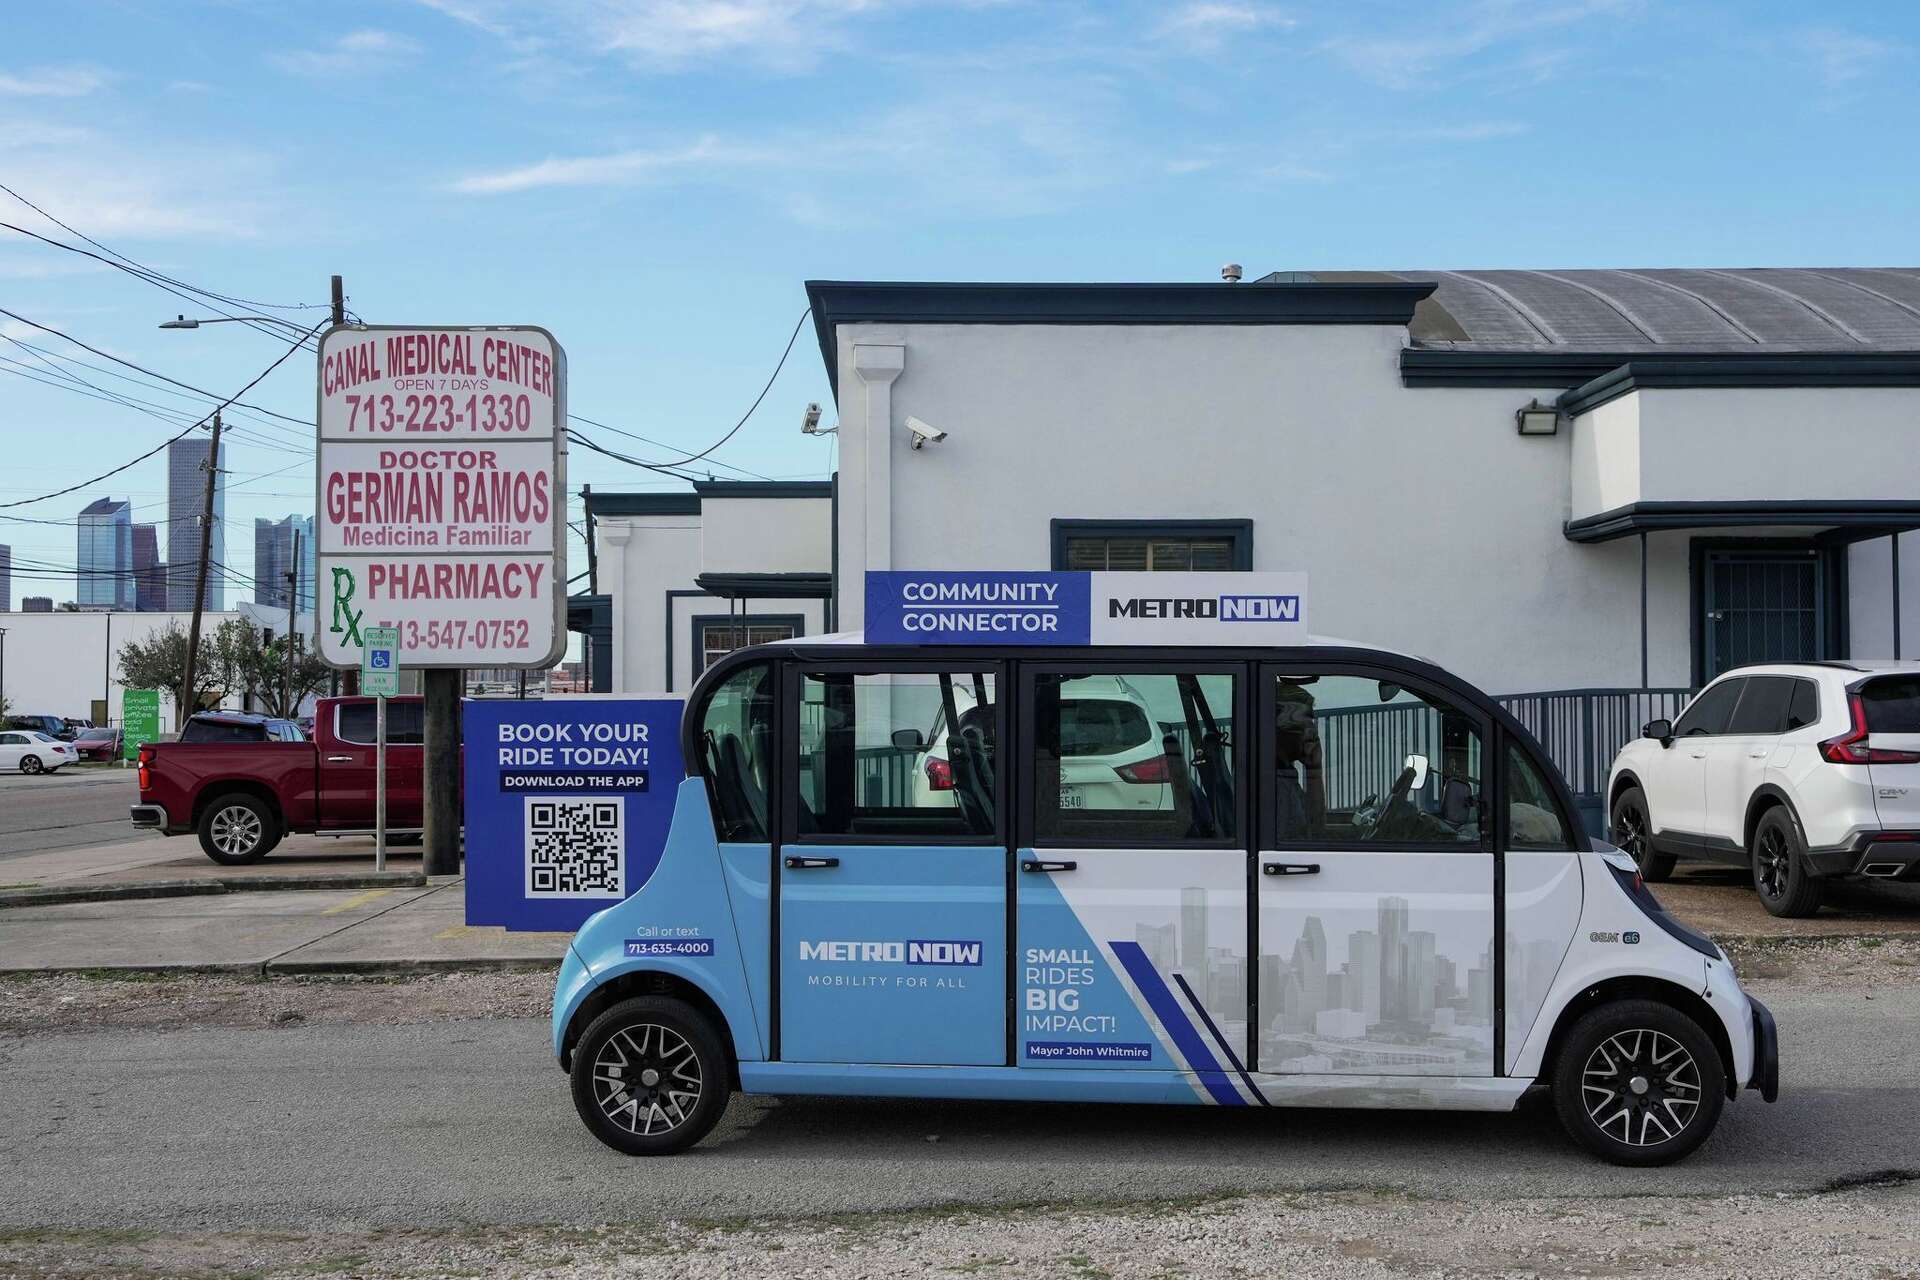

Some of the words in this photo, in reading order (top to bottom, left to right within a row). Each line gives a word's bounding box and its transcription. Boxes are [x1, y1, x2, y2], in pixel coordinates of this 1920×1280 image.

[324, 341, 381, 398] CANAL
[387, 333, 477, 378] MEDICAL
[483, 337, 552, 398] CENTER
[394, 379, 435, 391] OPEN
[440, 379, 447, 391] 7
[451, 379, 489, 391] DAYS
[345, 394, 531, 432] 713-223-1330
[379, 450, 497, 470] DOCTOR
[327, 471, 443, 525] GERMAN
[453, 470, 549, 524] RAMOS
[343, 525, 439, 546] Medicina
[446, 525, 532, 546] Familiar
[368, 563, 545, 600] PHARMACY
[902, 582, 1058, 601] COMMUNITY
[1109, 598, 1217, 618] METRO
[1223, 598, 1297, 619] NOW
[902, 613, 1058, 632] CONNECTOR
[379, 620, 529, 649] 13-547-0752
[499, 724, 572, 742] BOOK
[578, 724, 648, 742] YOUR
[499, 748, 554, 765] RIDE
[560, 748, 648, 765] TODAY!
[505, 776, 584, 787] DOWNLOAD
[588, 776, 613, 787] THE
[617, 776, 644, 787] APP
[637, 926, 658, 937] Call
[661, 928, 673, 937] or
[676, 927, 700, 937] text
[628, 943, 709, 954] 713-635-4000
[800, 941, 904, 962] METRO
[909, 942, 980, 964] NOW
[1026, 949, 1094, 964] SMALL
[808, 975, 888, 986] MOBILITY
[896, 977, 927, 987] FOR
[936, 978, 966, 988] ALL
[1026, 967, 1094, 985] RIDES
[1026, 988, 1079, 1011] BIG
[1026, 1015, 1116, 1033] IMPACT!
[1030, 1046, 1064, 1058] Mayor
[1067, 1046, 1093, 1056] John
[1096, 1046, 1149, 1057] Whitmire
